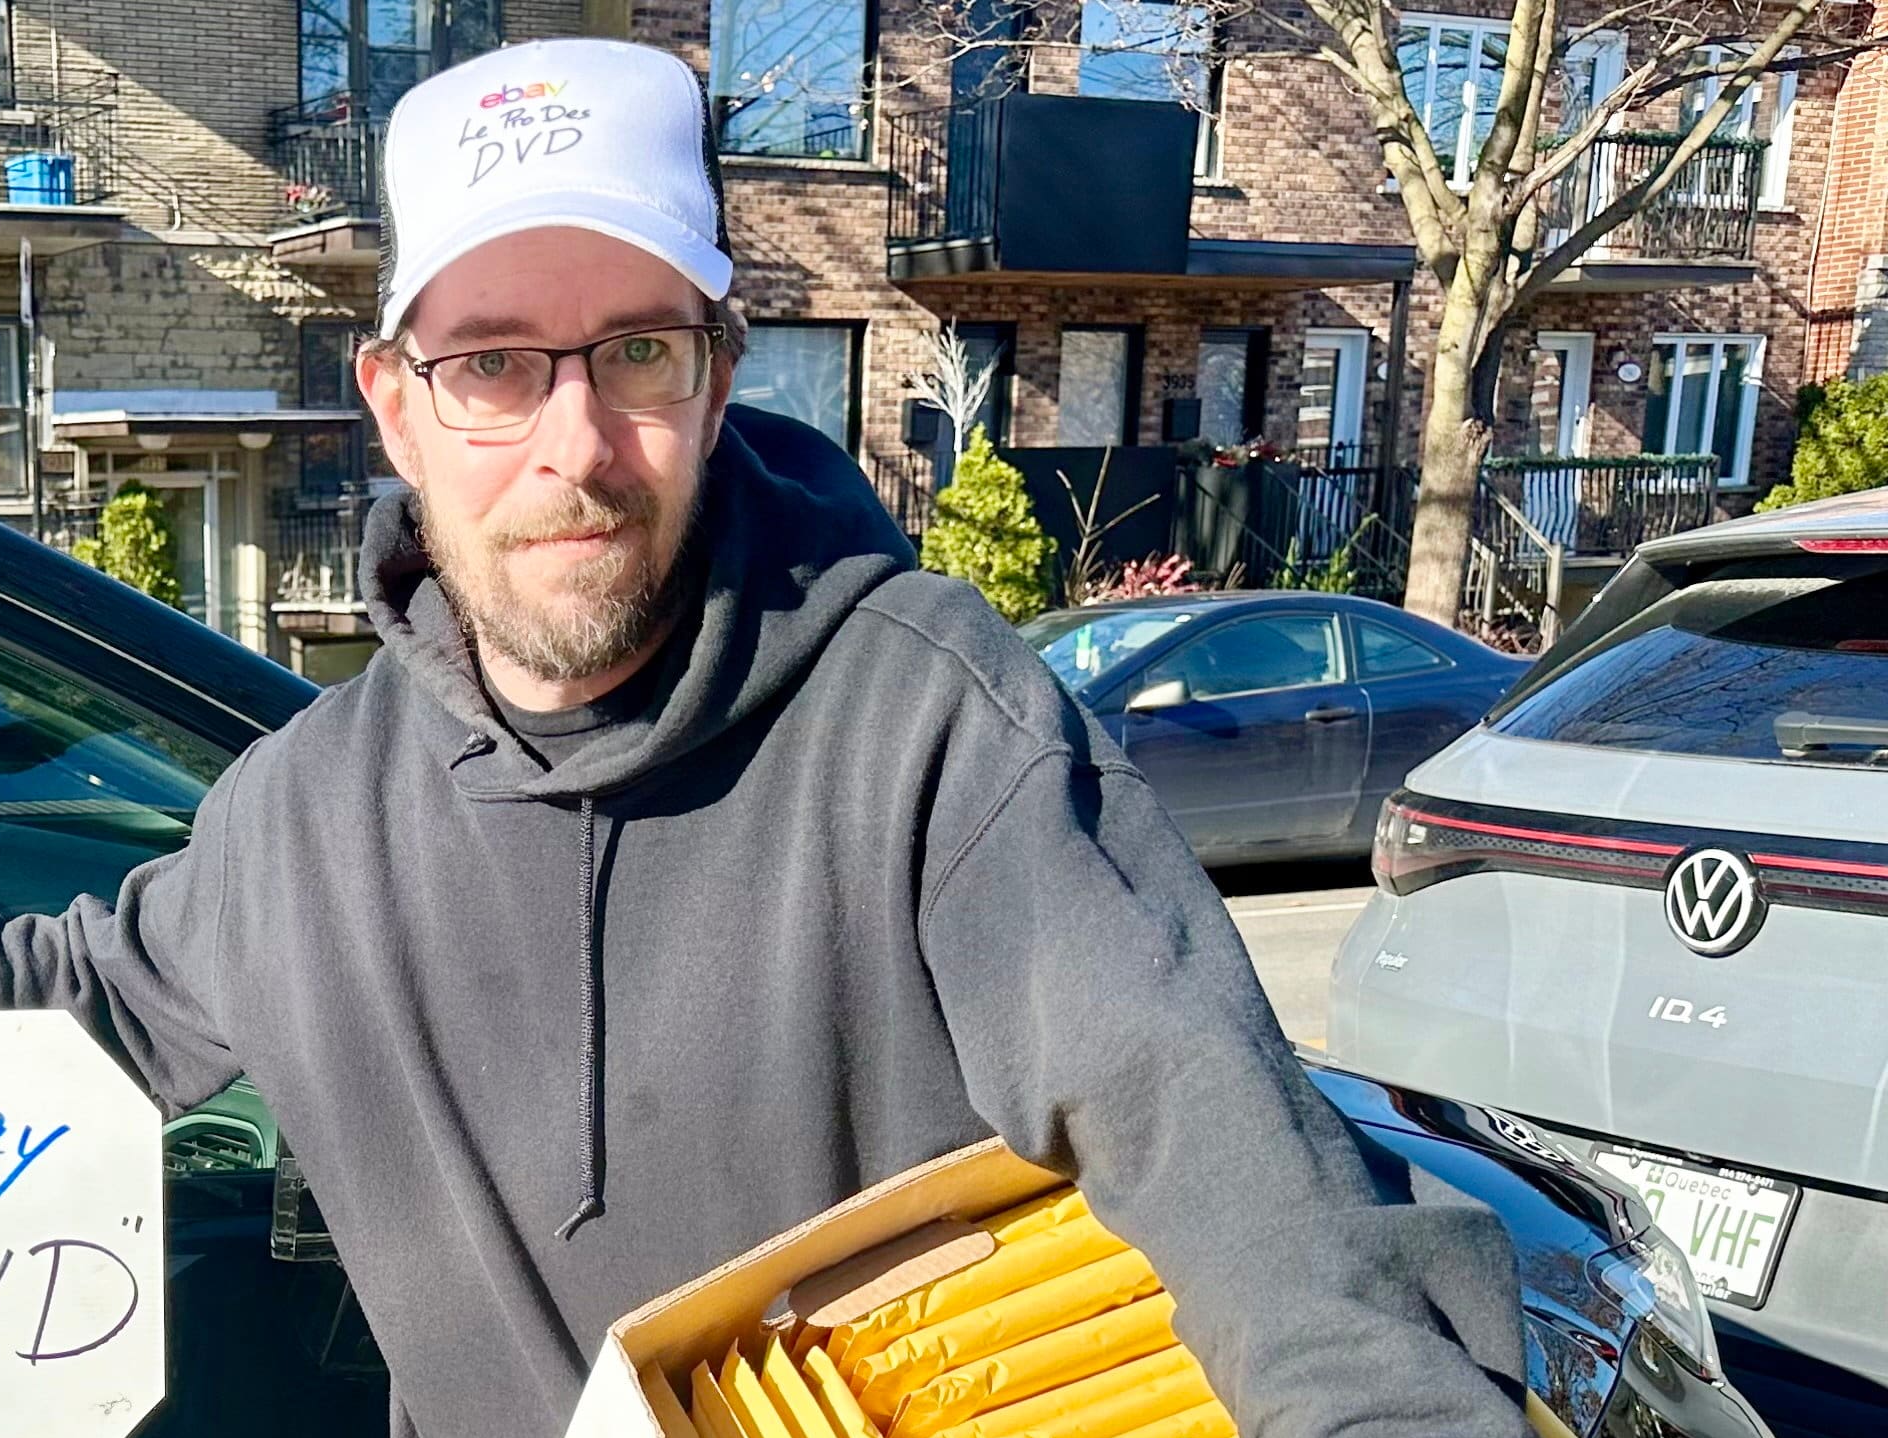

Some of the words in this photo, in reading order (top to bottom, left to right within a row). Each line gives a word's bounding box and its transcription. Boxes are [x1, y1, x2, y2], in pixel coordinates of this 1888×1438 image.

[479, 80, 568, 109] ebay
[458, 118, 488, 148] Le
[500, 107, 535, 129] Pro
[540, 104, 592, 123] Des
[466, 126, 583, 189] DVD
[1689, 1199, 1776, 1270] VHF
